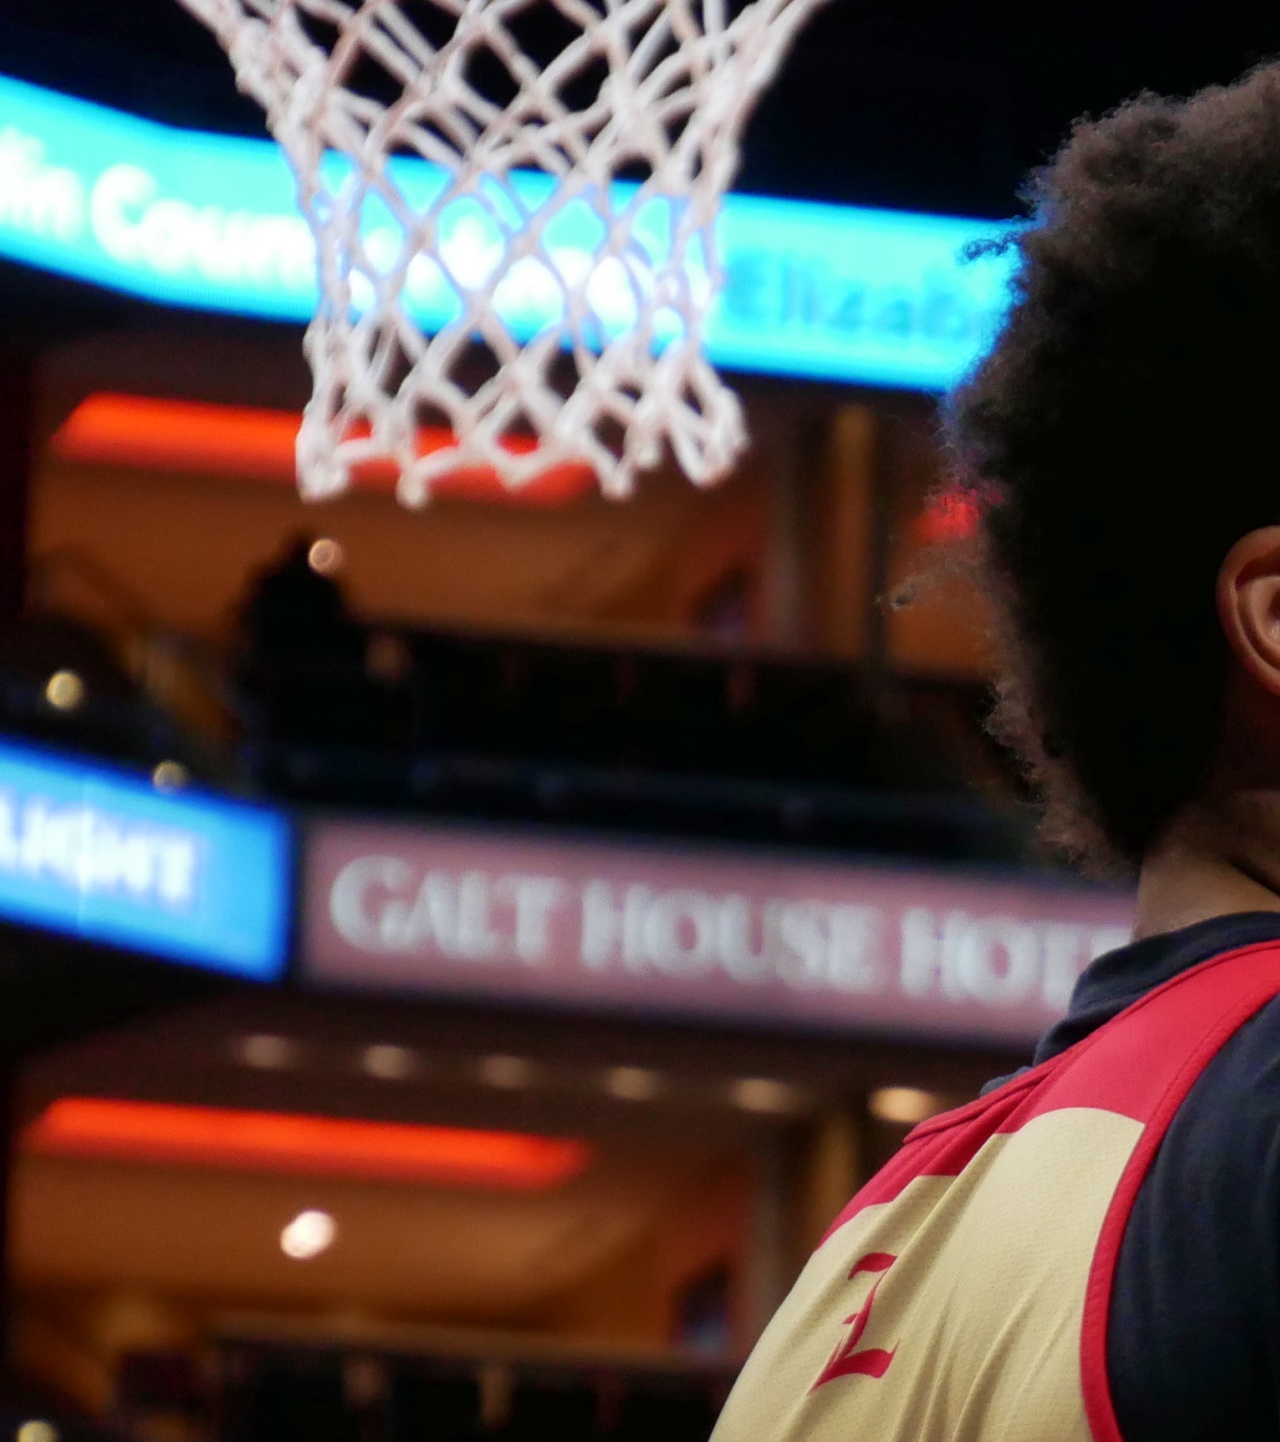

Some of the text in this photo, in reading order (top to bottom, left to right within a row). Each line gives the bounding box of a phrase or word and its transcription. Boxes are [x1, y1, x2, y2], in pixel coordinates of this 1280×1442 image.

[330, 855, 1135, 1014] GALT HOUSE HOT
